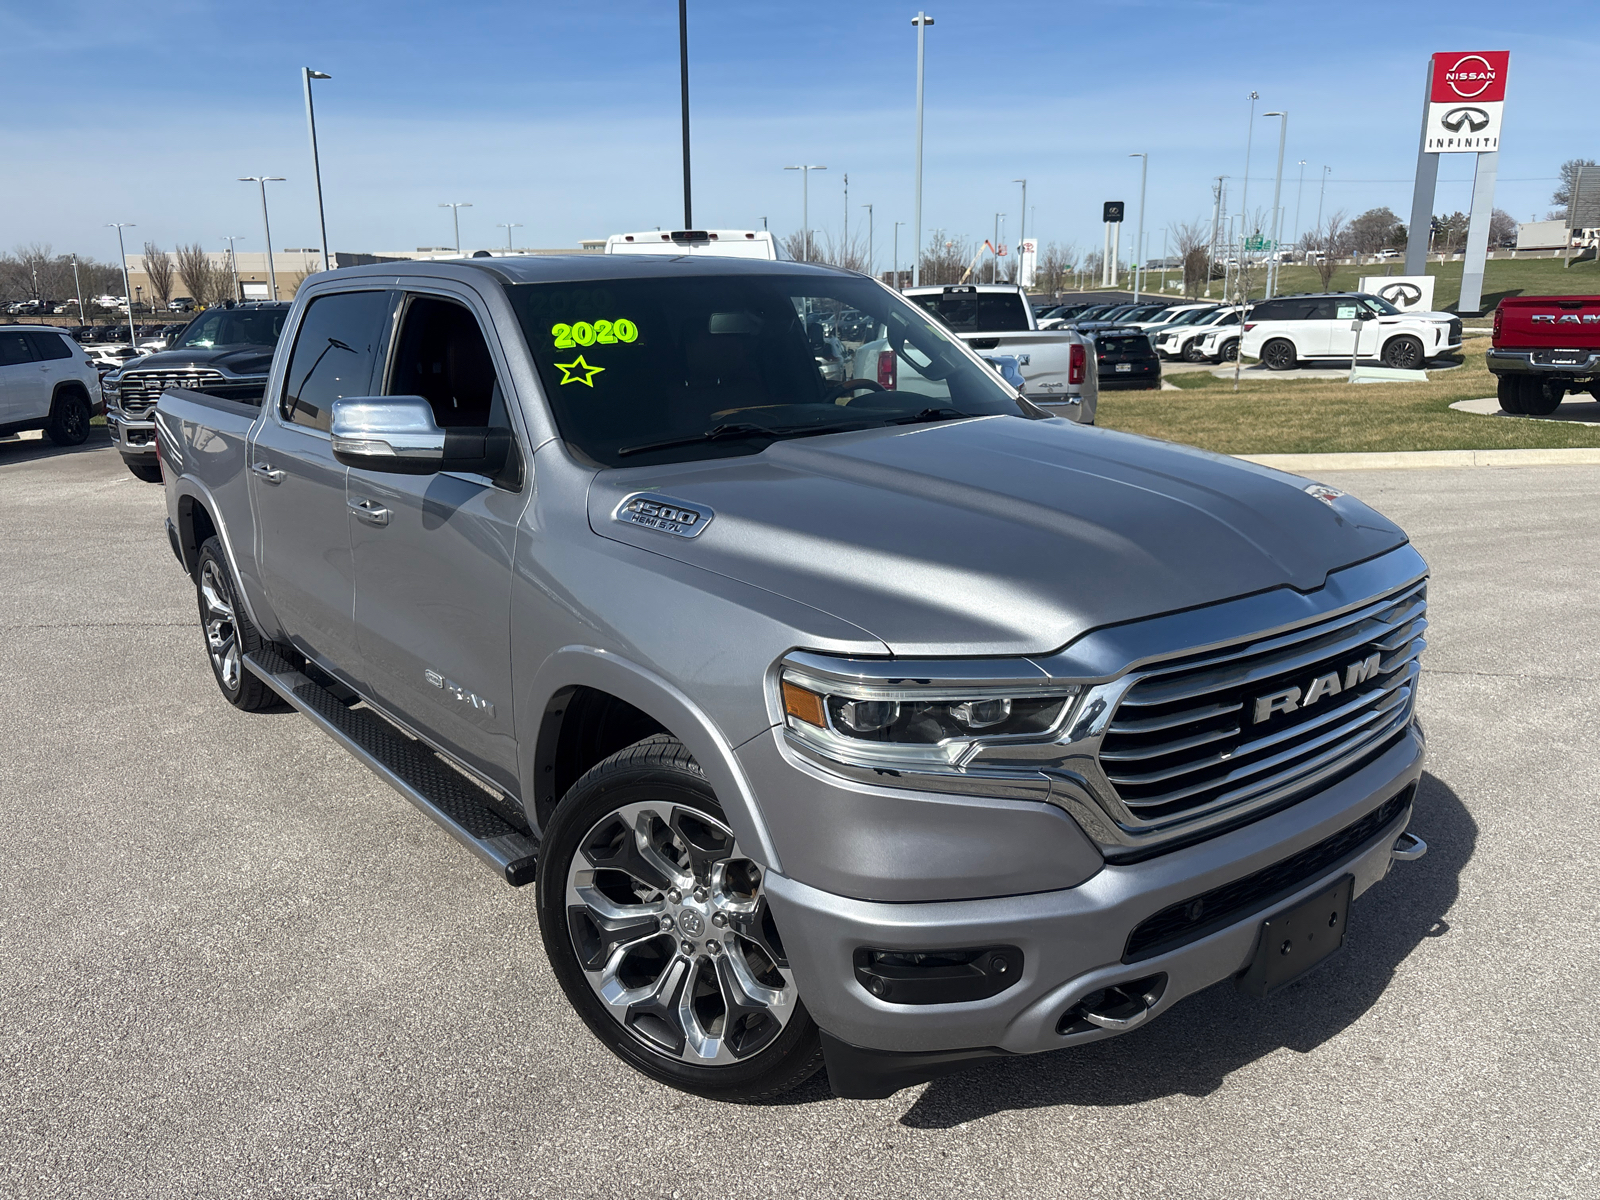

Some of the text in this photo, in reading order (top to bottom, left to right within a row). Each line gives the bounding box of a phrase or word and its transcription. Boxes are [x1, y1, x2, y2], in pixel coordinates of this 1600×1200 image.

[1445, 72, 1496, 80] NISSAN
[1428, 137, 1497, 148] INFINITI
[551, 318, 639, 349] 2020
[144, 379, 199, 389] RAM
[627, 500, 700, 526] 1500
[631, 513, 683, 533] HEMI 5.7L
[1253, 651, 1381, 725] RAM
